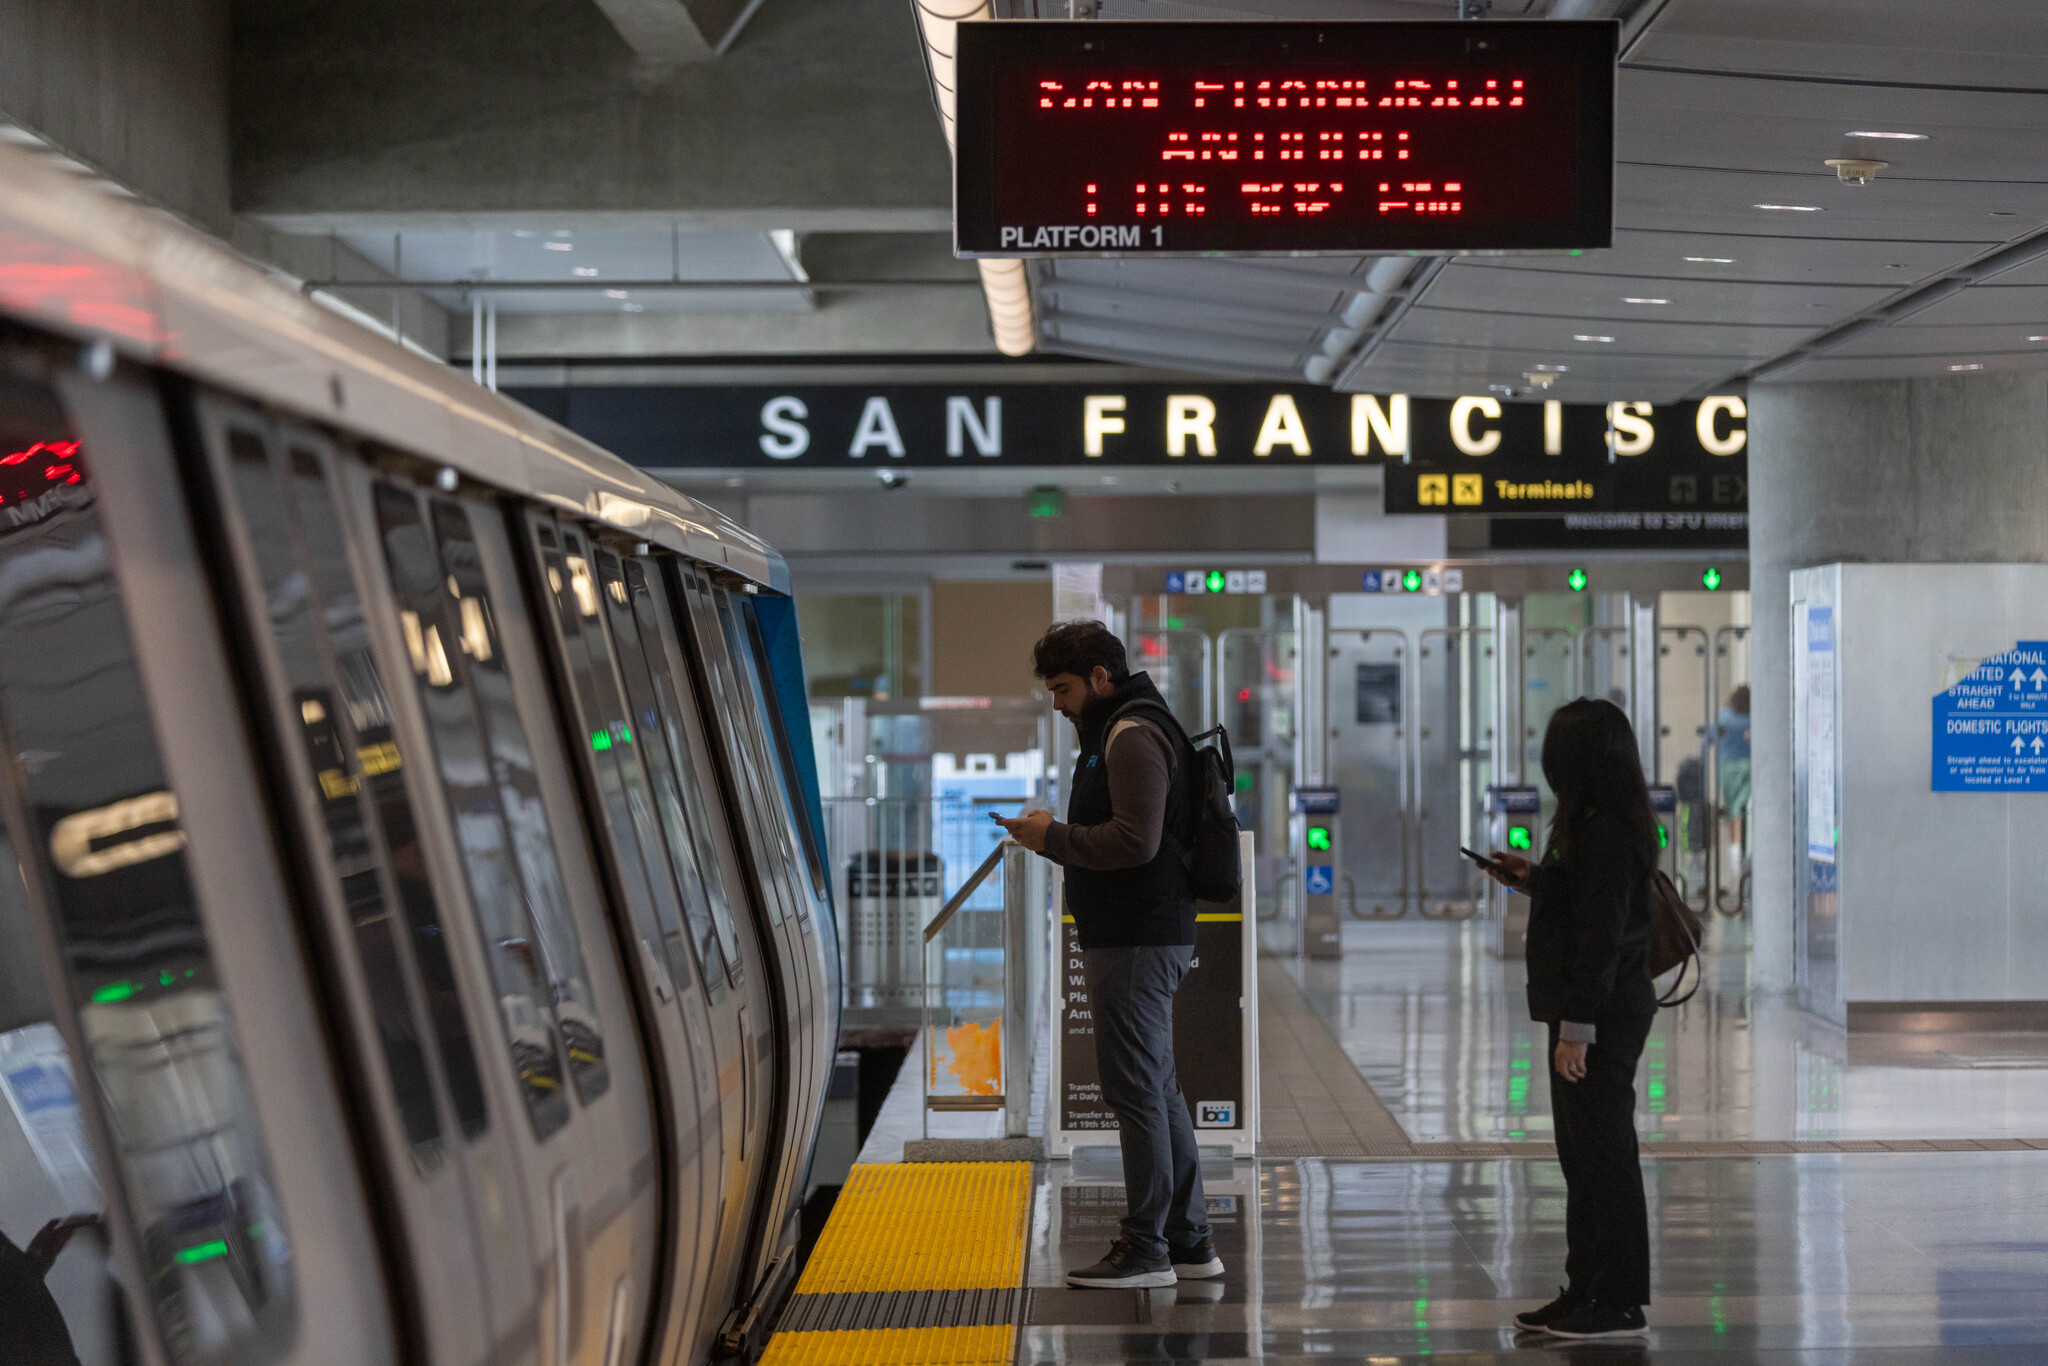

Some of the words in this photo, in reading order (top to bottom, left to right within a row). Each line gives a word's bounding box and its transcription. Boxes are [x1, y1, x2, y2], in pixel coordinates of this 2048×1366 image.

[1001, 225, 1141, 249] PLATFORM
[1151, 225, 1163, 247] 1
[759, 396, 1001, 460] SAN
[1495, 479, 1594, 499] Terminals
[1948, 685, 2003, 697] STRAIGHT
[1957, 697, 1995, 709] AHEAD
[1947, 719, 2001, 735] DOMESTIC
[2006, 719, 2048, 735] FLIGHTS
[1069, 992, 1088, 1003] Ple
[1068, 1026, 1085, 1035] and
[1079, 1092, 1099, 1102] Daly
[1068, 1111, 1102, 1119] Transfer
[1104, 1111, 1115, 1119] to
[1080, 1120, 1099, 1128] 19th
